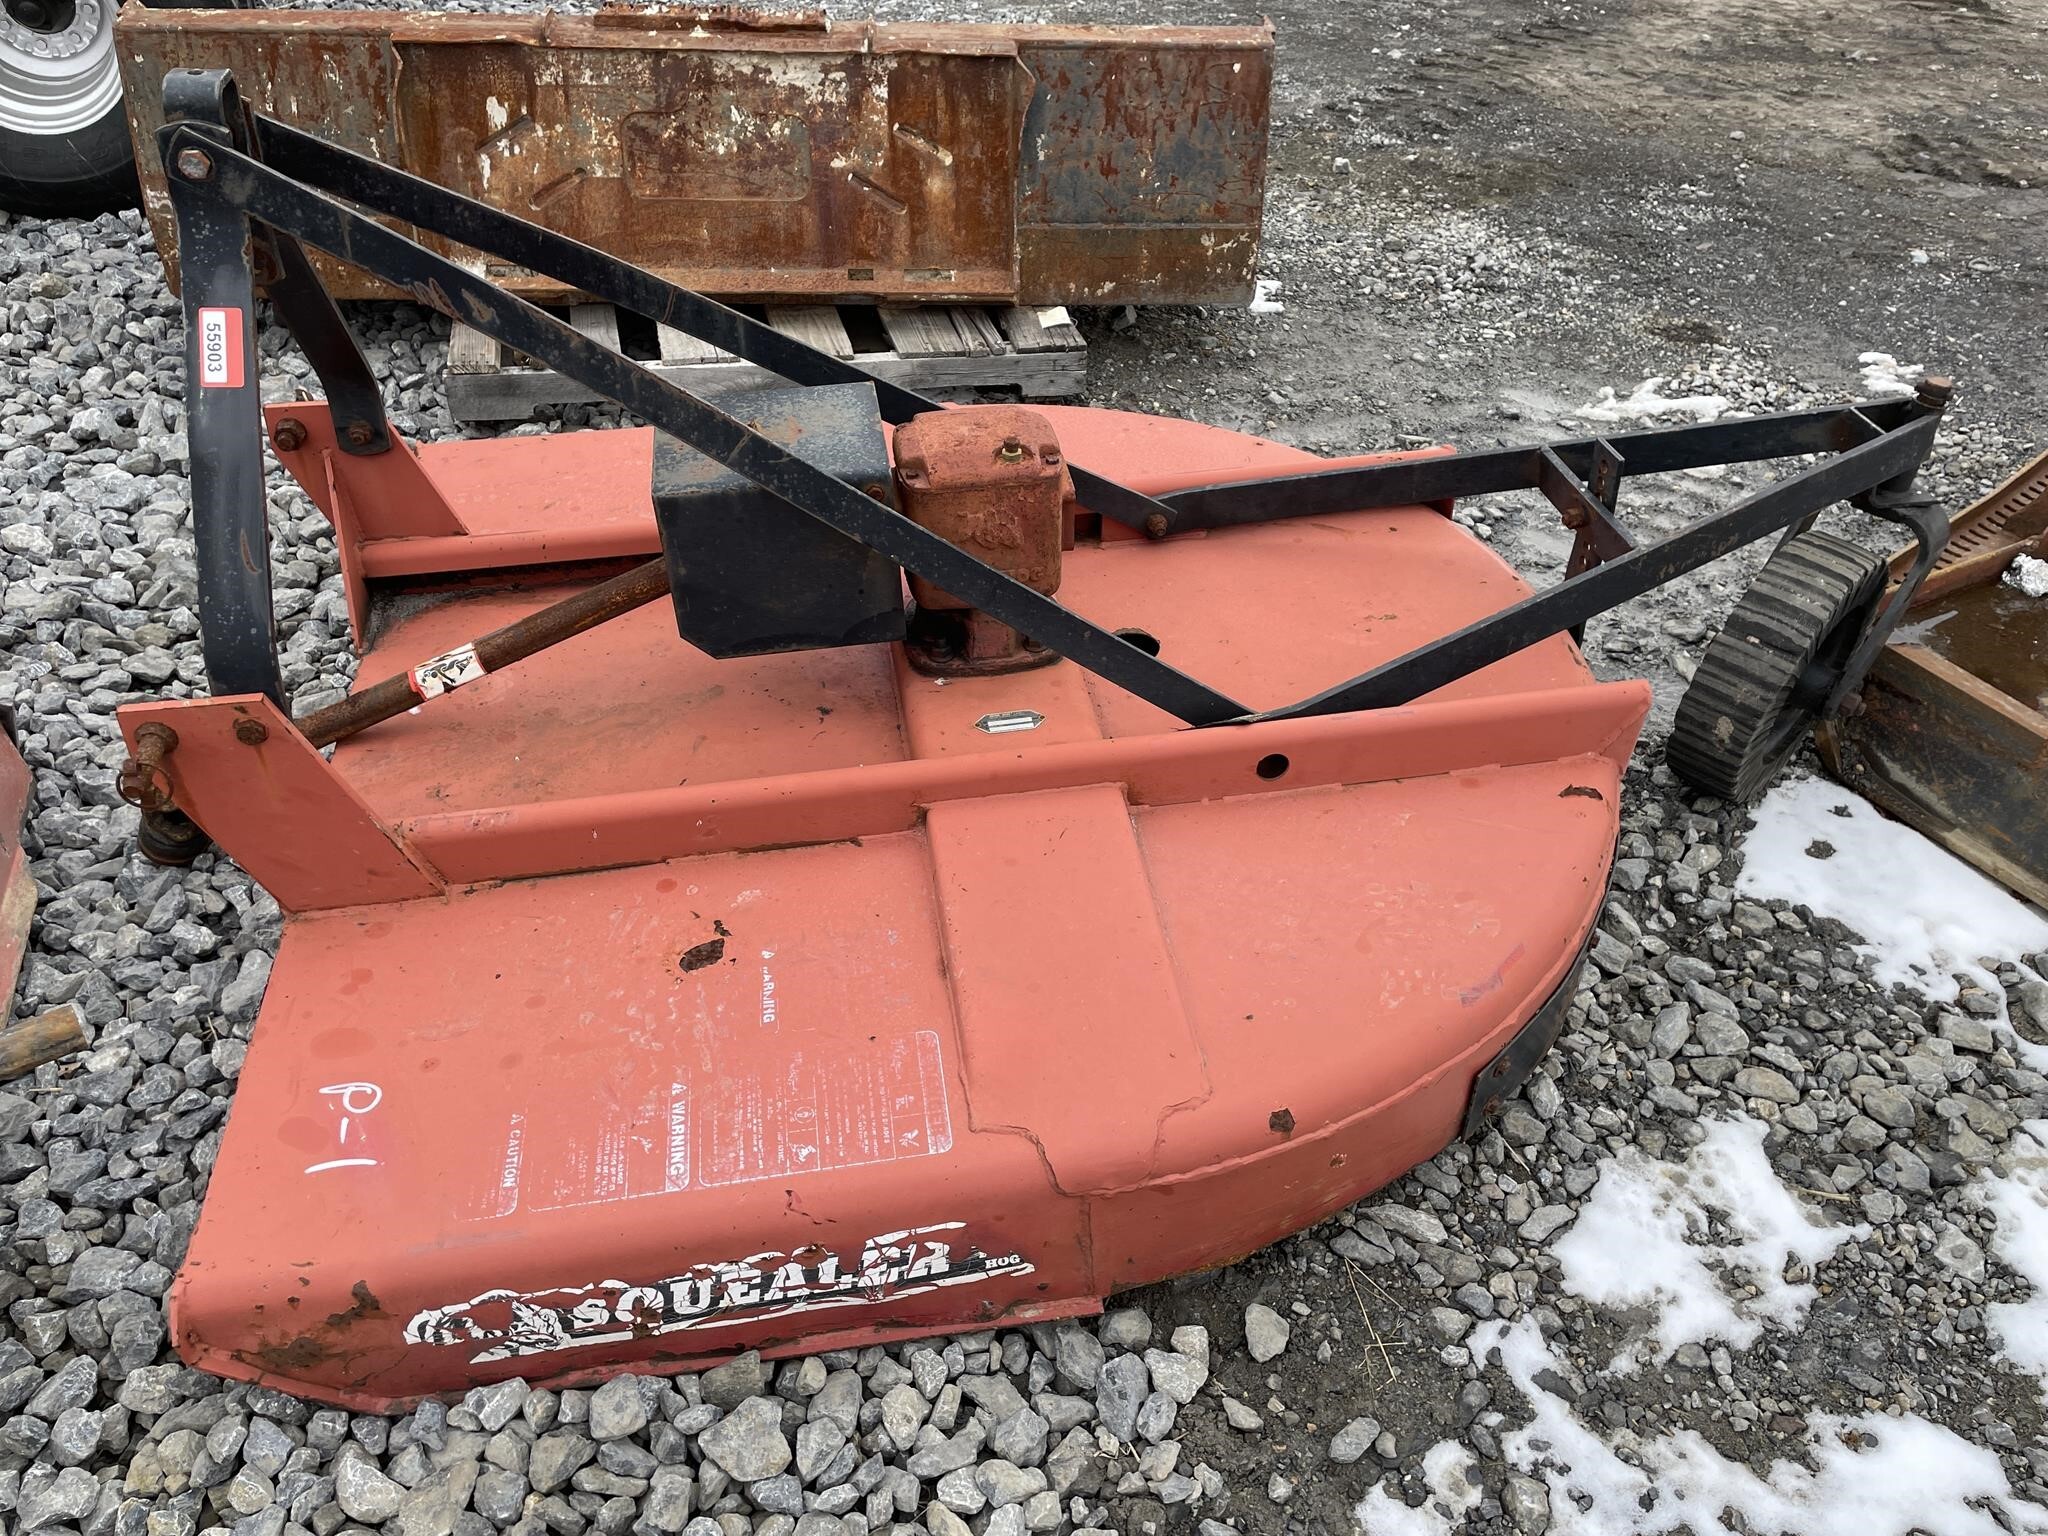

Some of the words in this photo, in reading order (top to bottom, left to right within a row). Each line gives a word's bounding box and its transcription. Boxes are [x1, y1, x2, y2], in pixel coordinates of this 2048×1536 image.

[206, 322, 222, 373] 55903
[502, 1129, 521, 1188] CAUTION
[670, 1100, 686, 1177] WARNING
[571, 1240, 950, 1329] SQUEALER
[985, 1254, 1021, 1269] HOG
